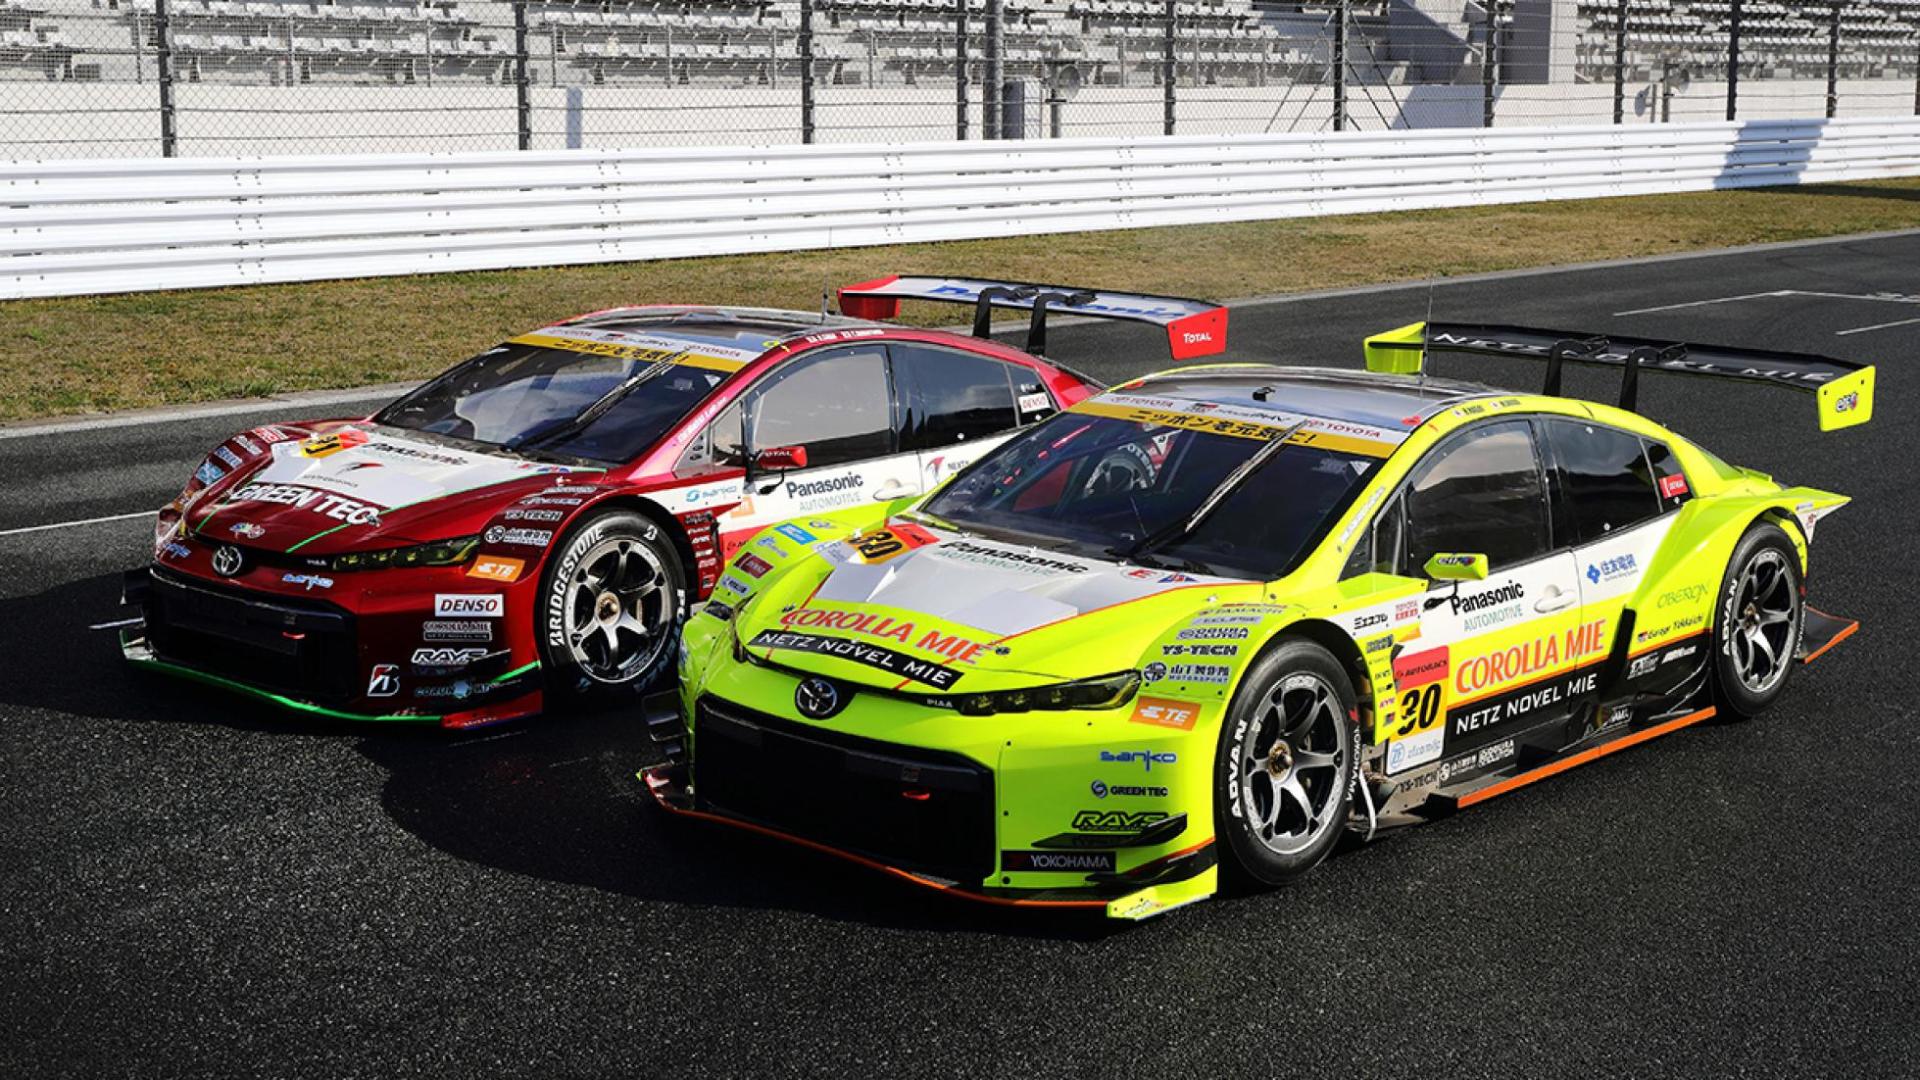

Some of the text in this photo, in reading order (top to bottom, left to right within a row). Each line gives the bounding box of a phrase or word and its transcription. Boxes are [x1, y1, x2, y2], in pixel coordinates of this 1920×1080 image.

[1183, 331, 1212, 343] TOTAL
[1326, 424, 1381, 439] TOYOTA
[786, 471, 865, 499] Panasonic
[800, 491, 862, 512] AUTOMOTIVE
[230, 484, 379, 525] GREEN TEC
[939, 540, 1090, 574] Panasonic
[549, 526, 604, 647] BRIDGESTONE
[1450, 579, 1525, 616] Panasonic
[440, 599, 498, 612] DENSO
[1463, 604, 1524, 632] AUTOMOTIVE
[780, 608, 991, 664] COROLLA MIE
[1162, 644, 1239, 656] YS-TECH
[760, 631, 954, 685] NETZ NOVEL MIE
[1455, 619, 1607, 695] COROLLA MIE
[1397, 683, 1442, 737] 30
[1455, 673, 1598, 736] NETZ NOVEL MIE
[1100, 750, 1177, 772] sanko
[1228, 718, 1249, 819] ADVAN
[1346, 725, 1363, 802] YOKOHAMA
[1110, 786, 1169, 798] GREEN TEC
[1030, 855, 1111, 868] YOKOHAMA
